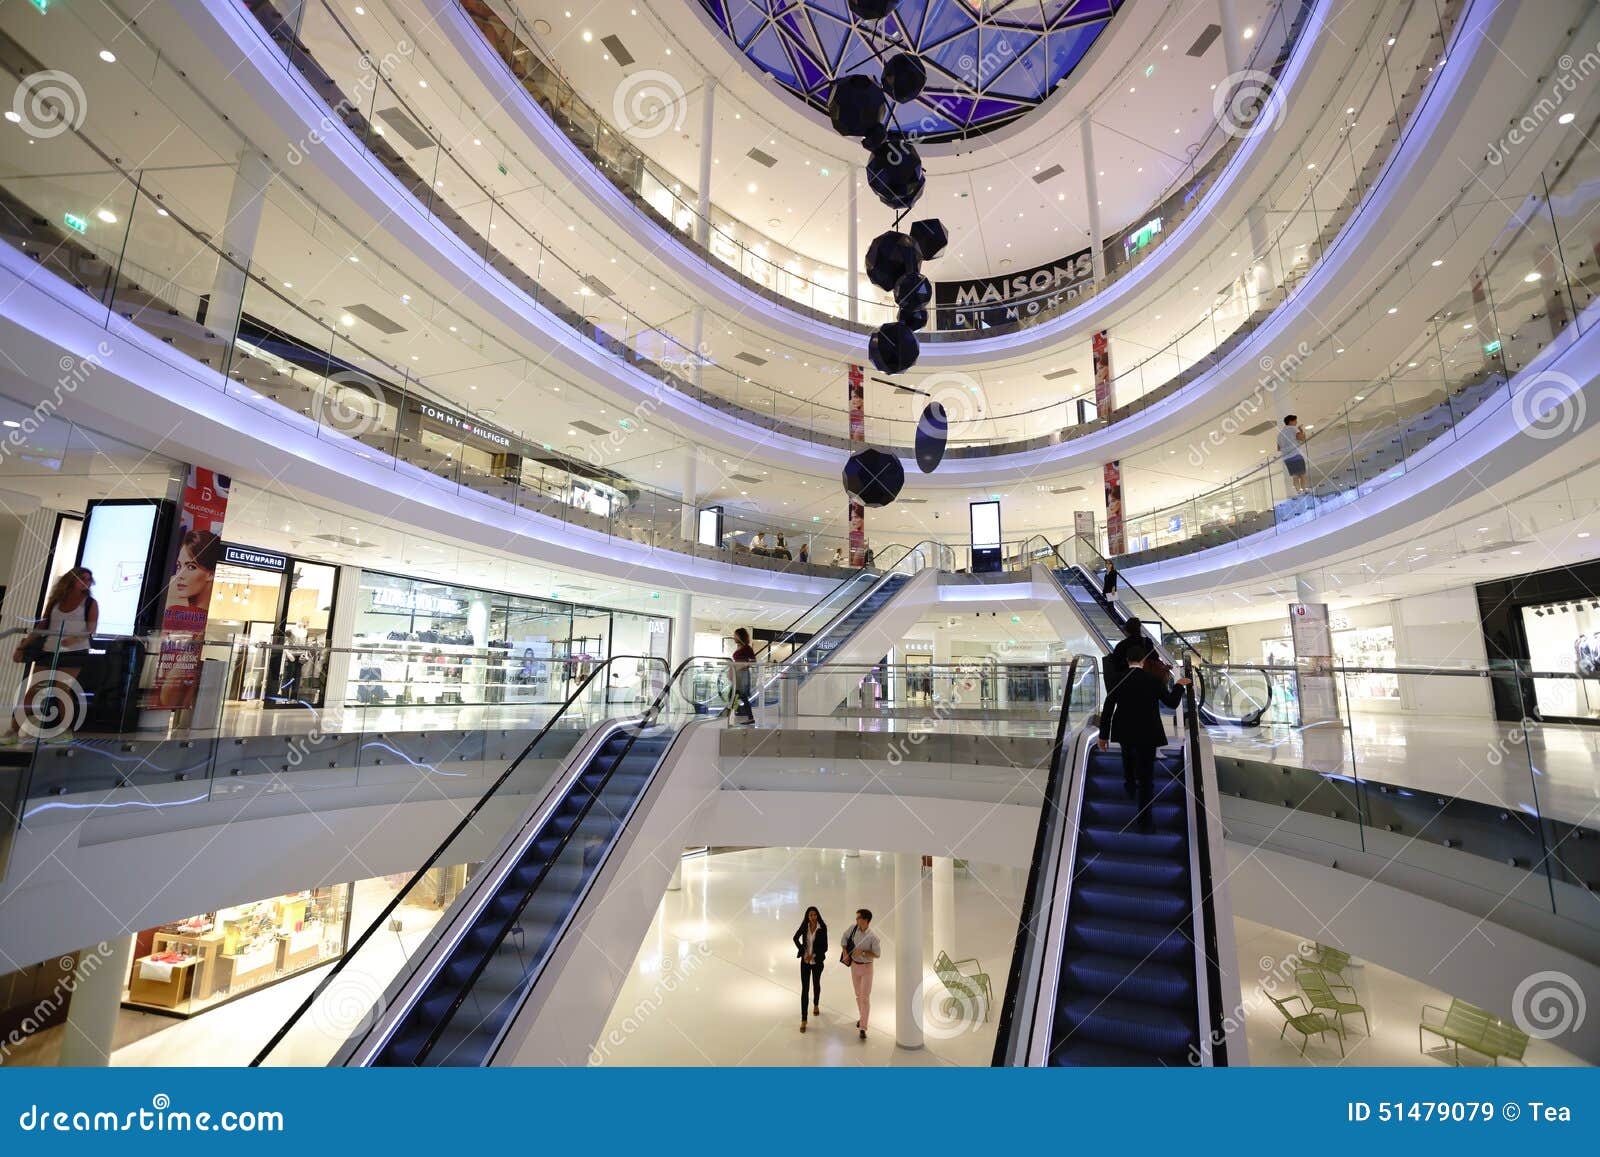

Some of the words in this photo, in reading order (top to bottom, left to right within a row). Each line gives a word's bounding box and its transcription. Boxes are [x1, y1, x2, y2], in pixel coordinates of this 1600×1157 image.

[955, 253, 1094, 305] MAISONS
[421, 405, 460, 427] TOMMY
[474, 427, 510, 447] HILFIGER
[230, 552, 282, 566] ELEVENPARIS
